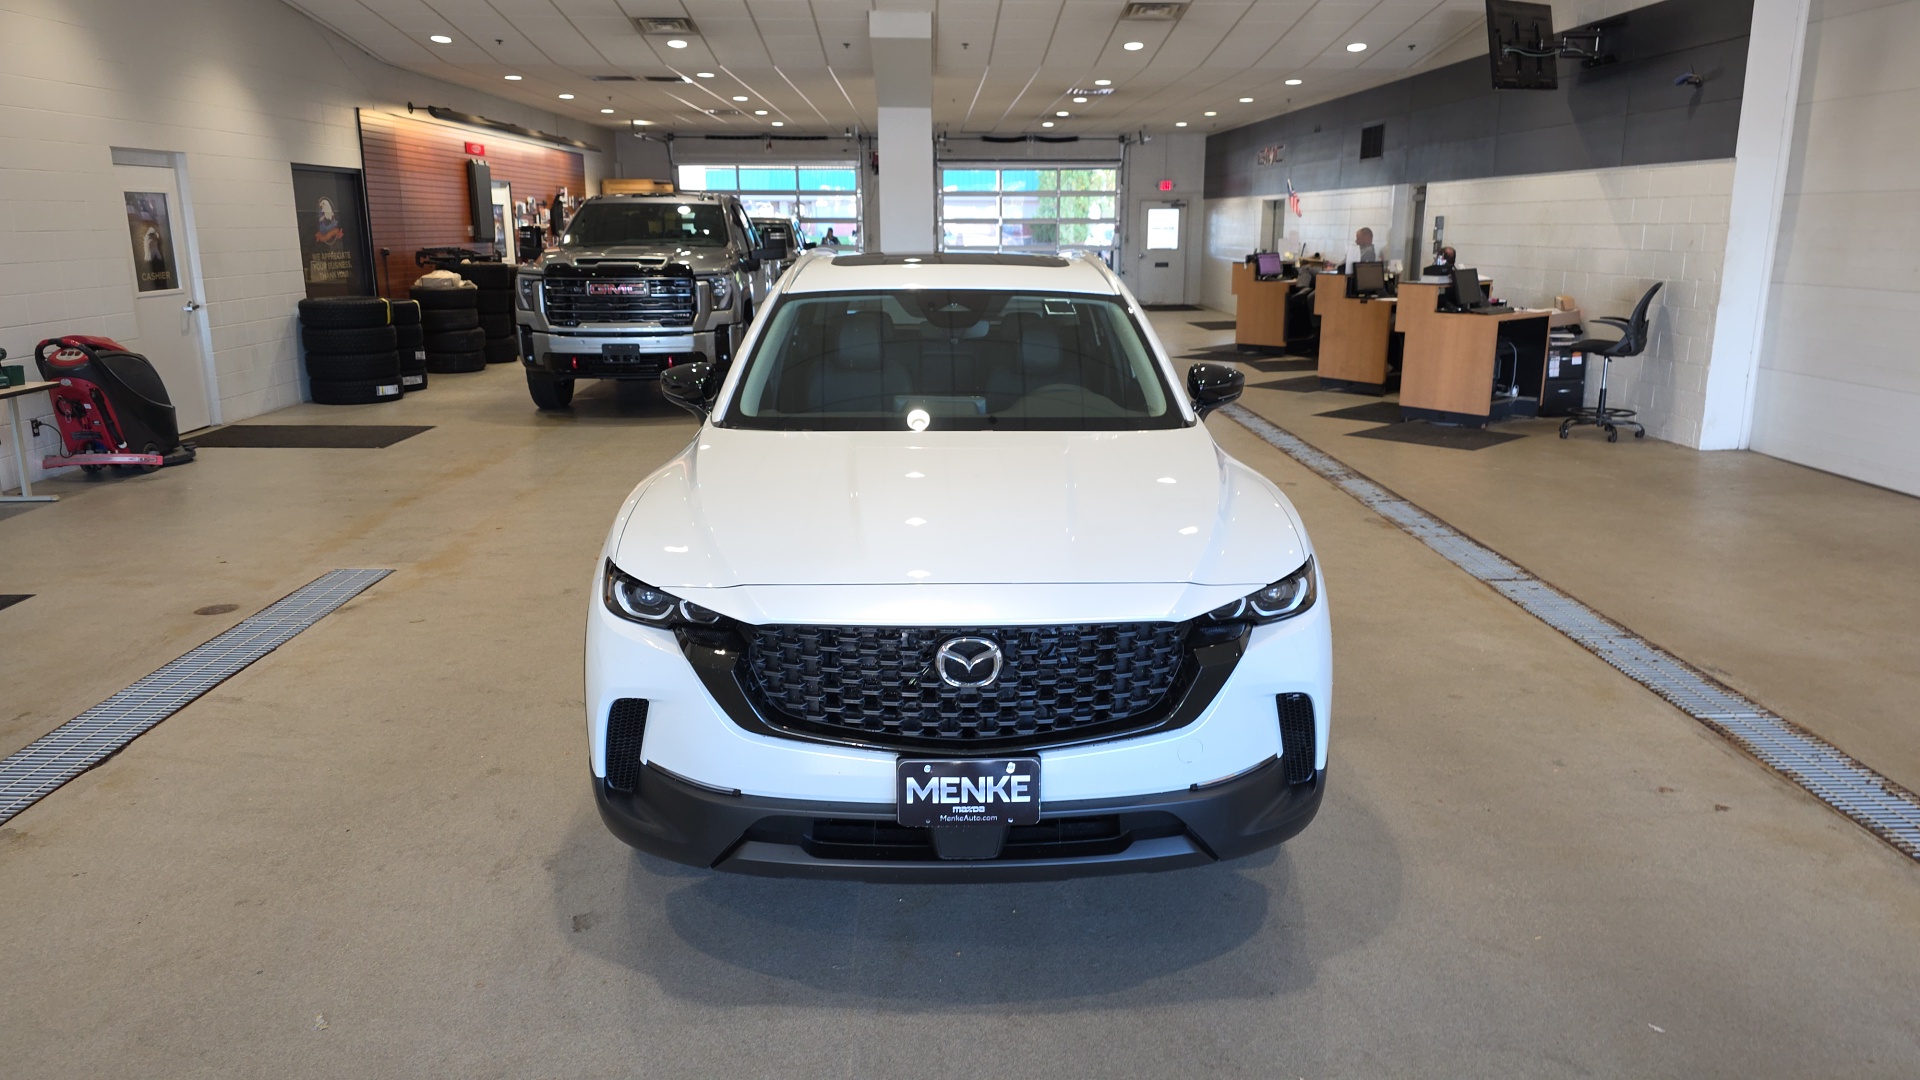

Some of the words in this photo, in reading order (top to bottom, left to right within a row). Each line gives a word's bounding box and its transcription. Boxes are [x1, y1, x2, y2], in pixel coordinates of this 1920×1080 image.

[142, 272, 170, 281] CASHIER
[590, 283, 645, 295] GMC
[906, 775, 1031, 804] MENKE
